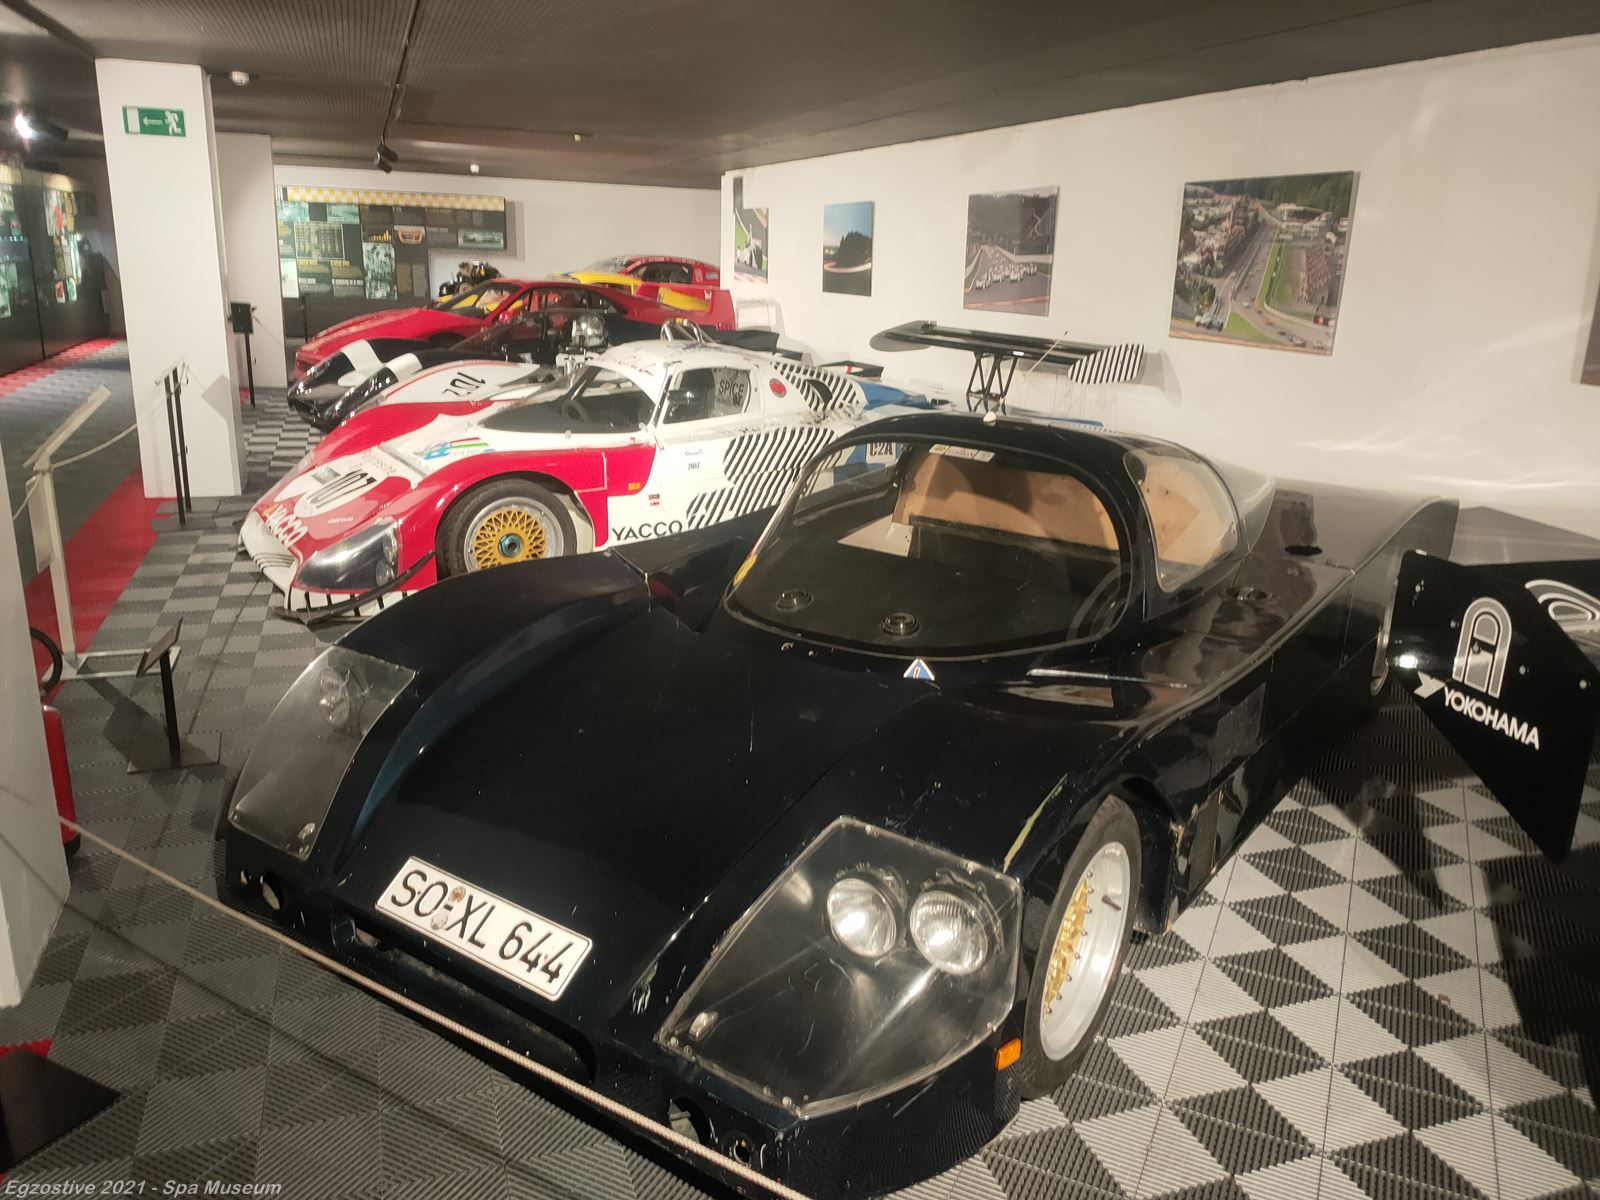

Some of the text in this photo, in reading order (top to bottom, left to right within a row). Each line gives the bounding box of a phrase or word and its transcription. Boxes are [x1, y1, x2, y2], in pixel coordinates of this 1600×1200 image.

[719, 379, 745, 399] SPICE
[611, 520, 683, 541] YACCO
[1444, 686, 1541, 751] YOKOHAMA
[498, 919, 575, 984] 644
